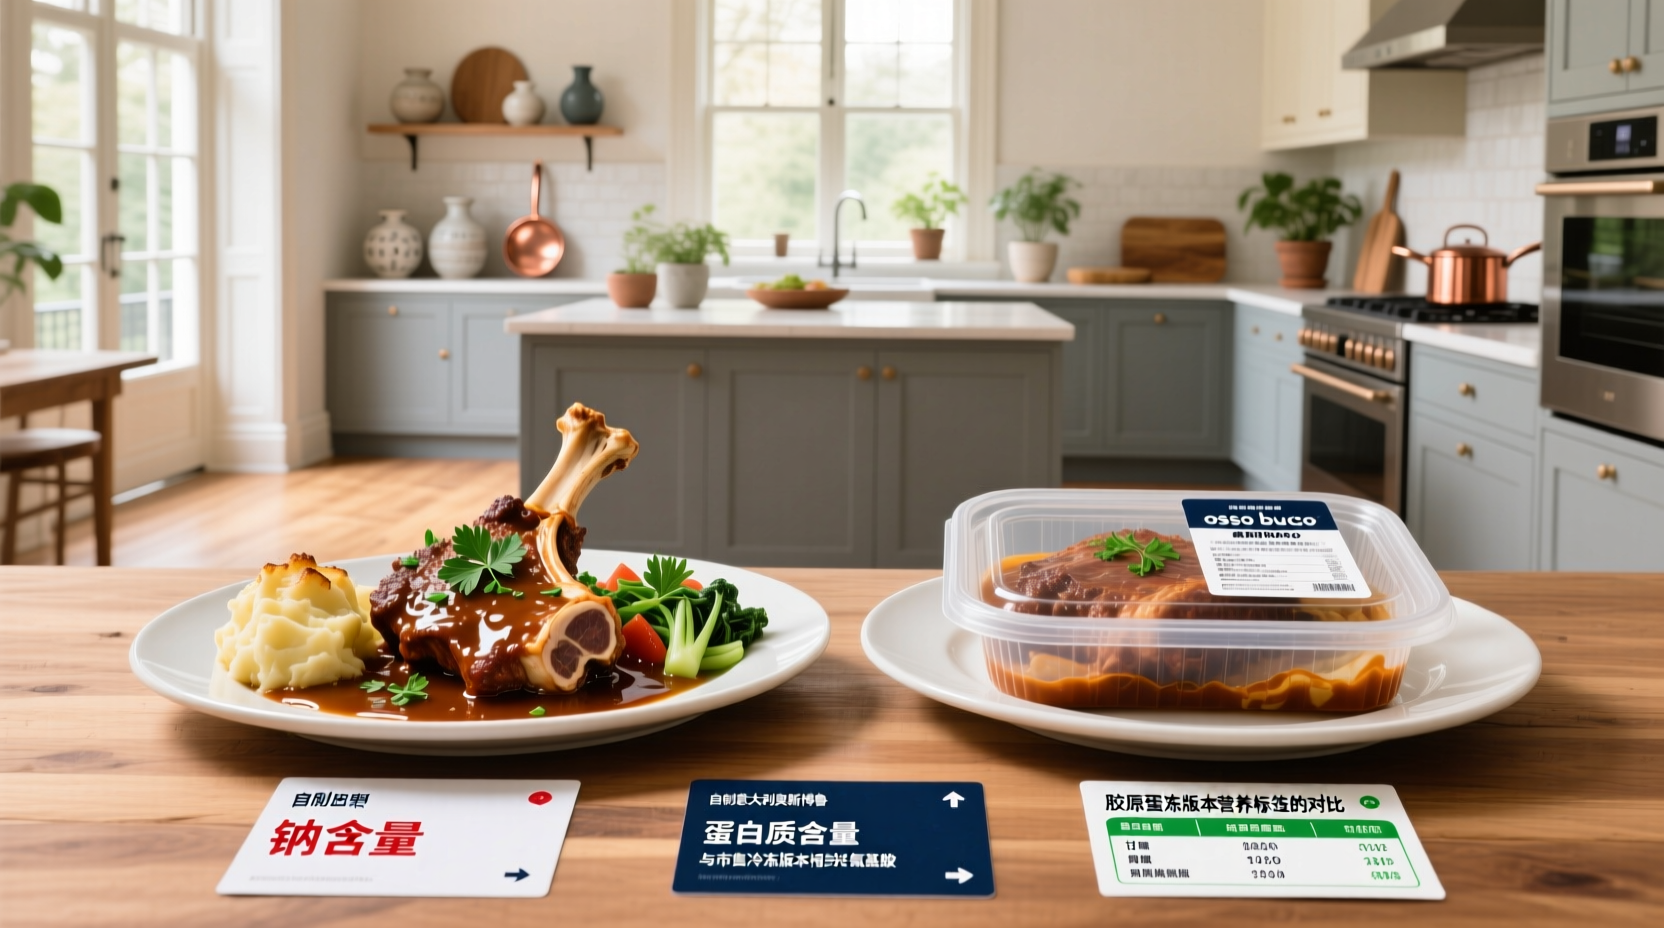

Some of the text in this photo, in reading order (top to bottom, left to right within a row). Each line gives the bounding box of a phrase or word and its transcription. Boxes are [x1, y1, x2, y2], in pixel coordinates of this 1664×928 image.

[1204, 514, 1254, 526] osso
[269, 818, 424, 857] 钠含量
[703, 820, 860, 846] 蛋白质含量
